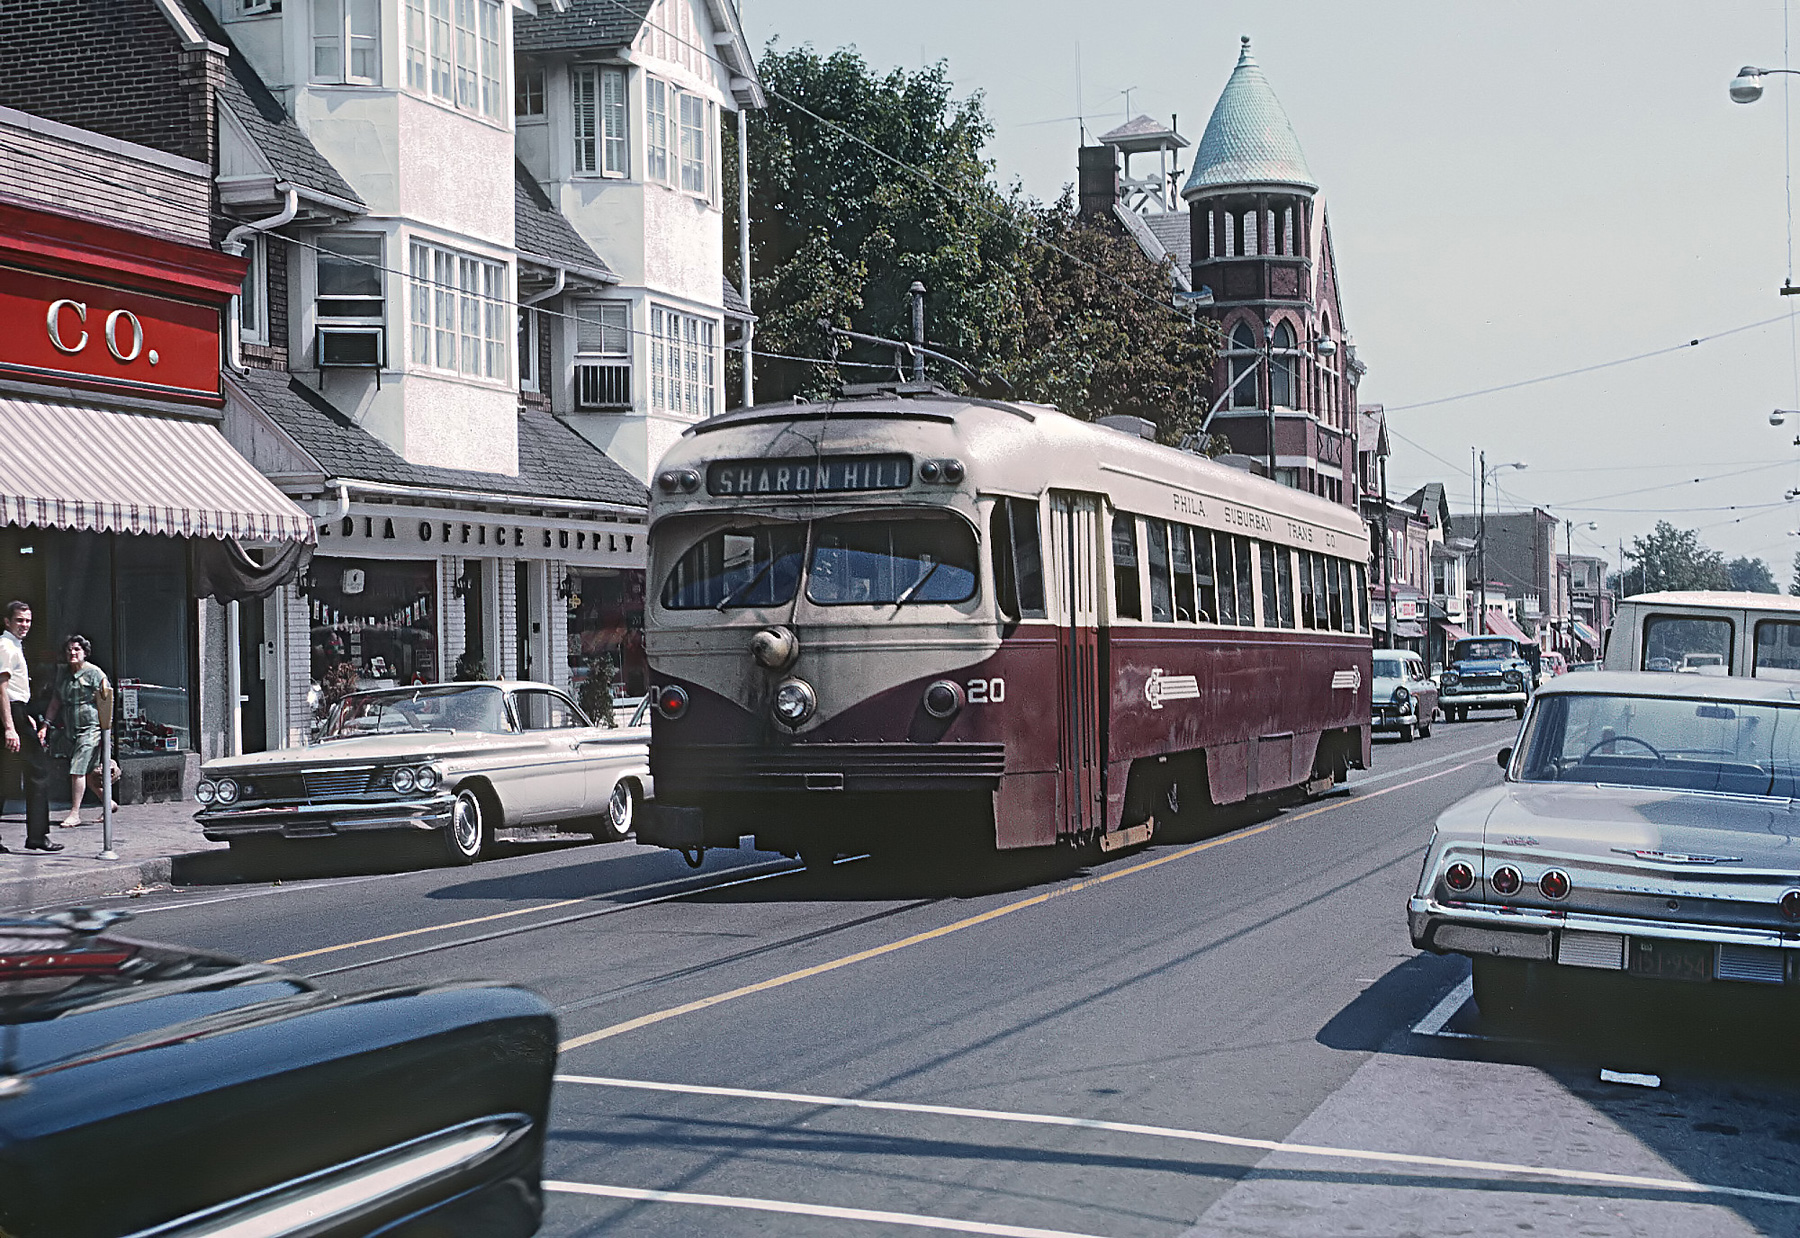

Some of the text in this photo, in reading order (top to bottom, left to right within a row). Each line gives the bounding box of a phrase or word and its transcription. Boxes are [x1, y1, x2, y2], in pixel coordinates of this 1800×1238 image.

[46, 298, 160, 366] CO.
[719, 461, 906, 494] SHARON HILL
[319, 515, 634, 553] EDIA OFFICE SUPPLY
[1224, 506, 1273, 533] SUBURBAN
[967, 677, 1005, 703] 20
